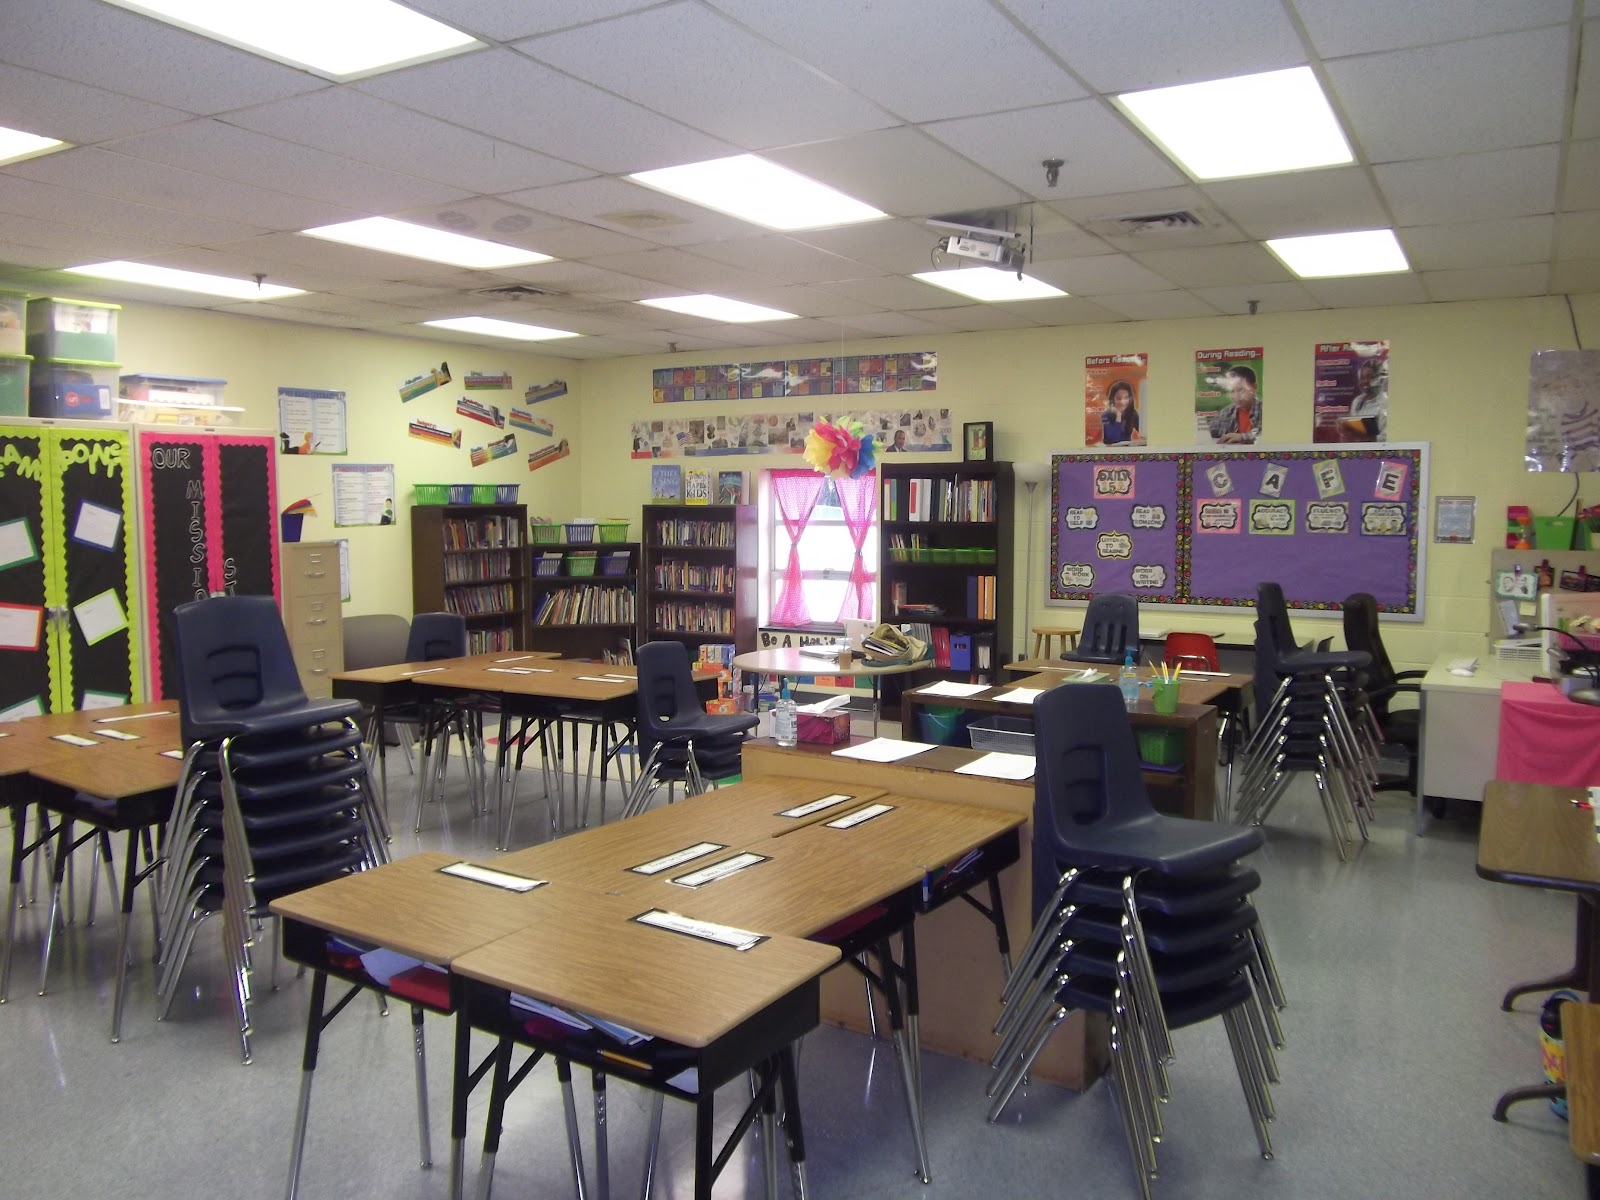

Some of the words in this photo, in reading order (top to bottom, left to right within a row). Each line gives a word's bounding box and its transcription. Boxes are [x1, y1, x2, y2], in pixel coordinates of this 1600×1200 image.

[1087, 357, 1110, 365] Before
[1197, 352, 1222, 360] During
[153, 448, 191, 470] OUR
[1100, 471, 1128, 481] DAILY
[1109, 481, 1116, 492] 5
[687, 489, 707, 498] KIDS
[761, 632, 778, 647] Be
[782, 634, 792, 648] A
